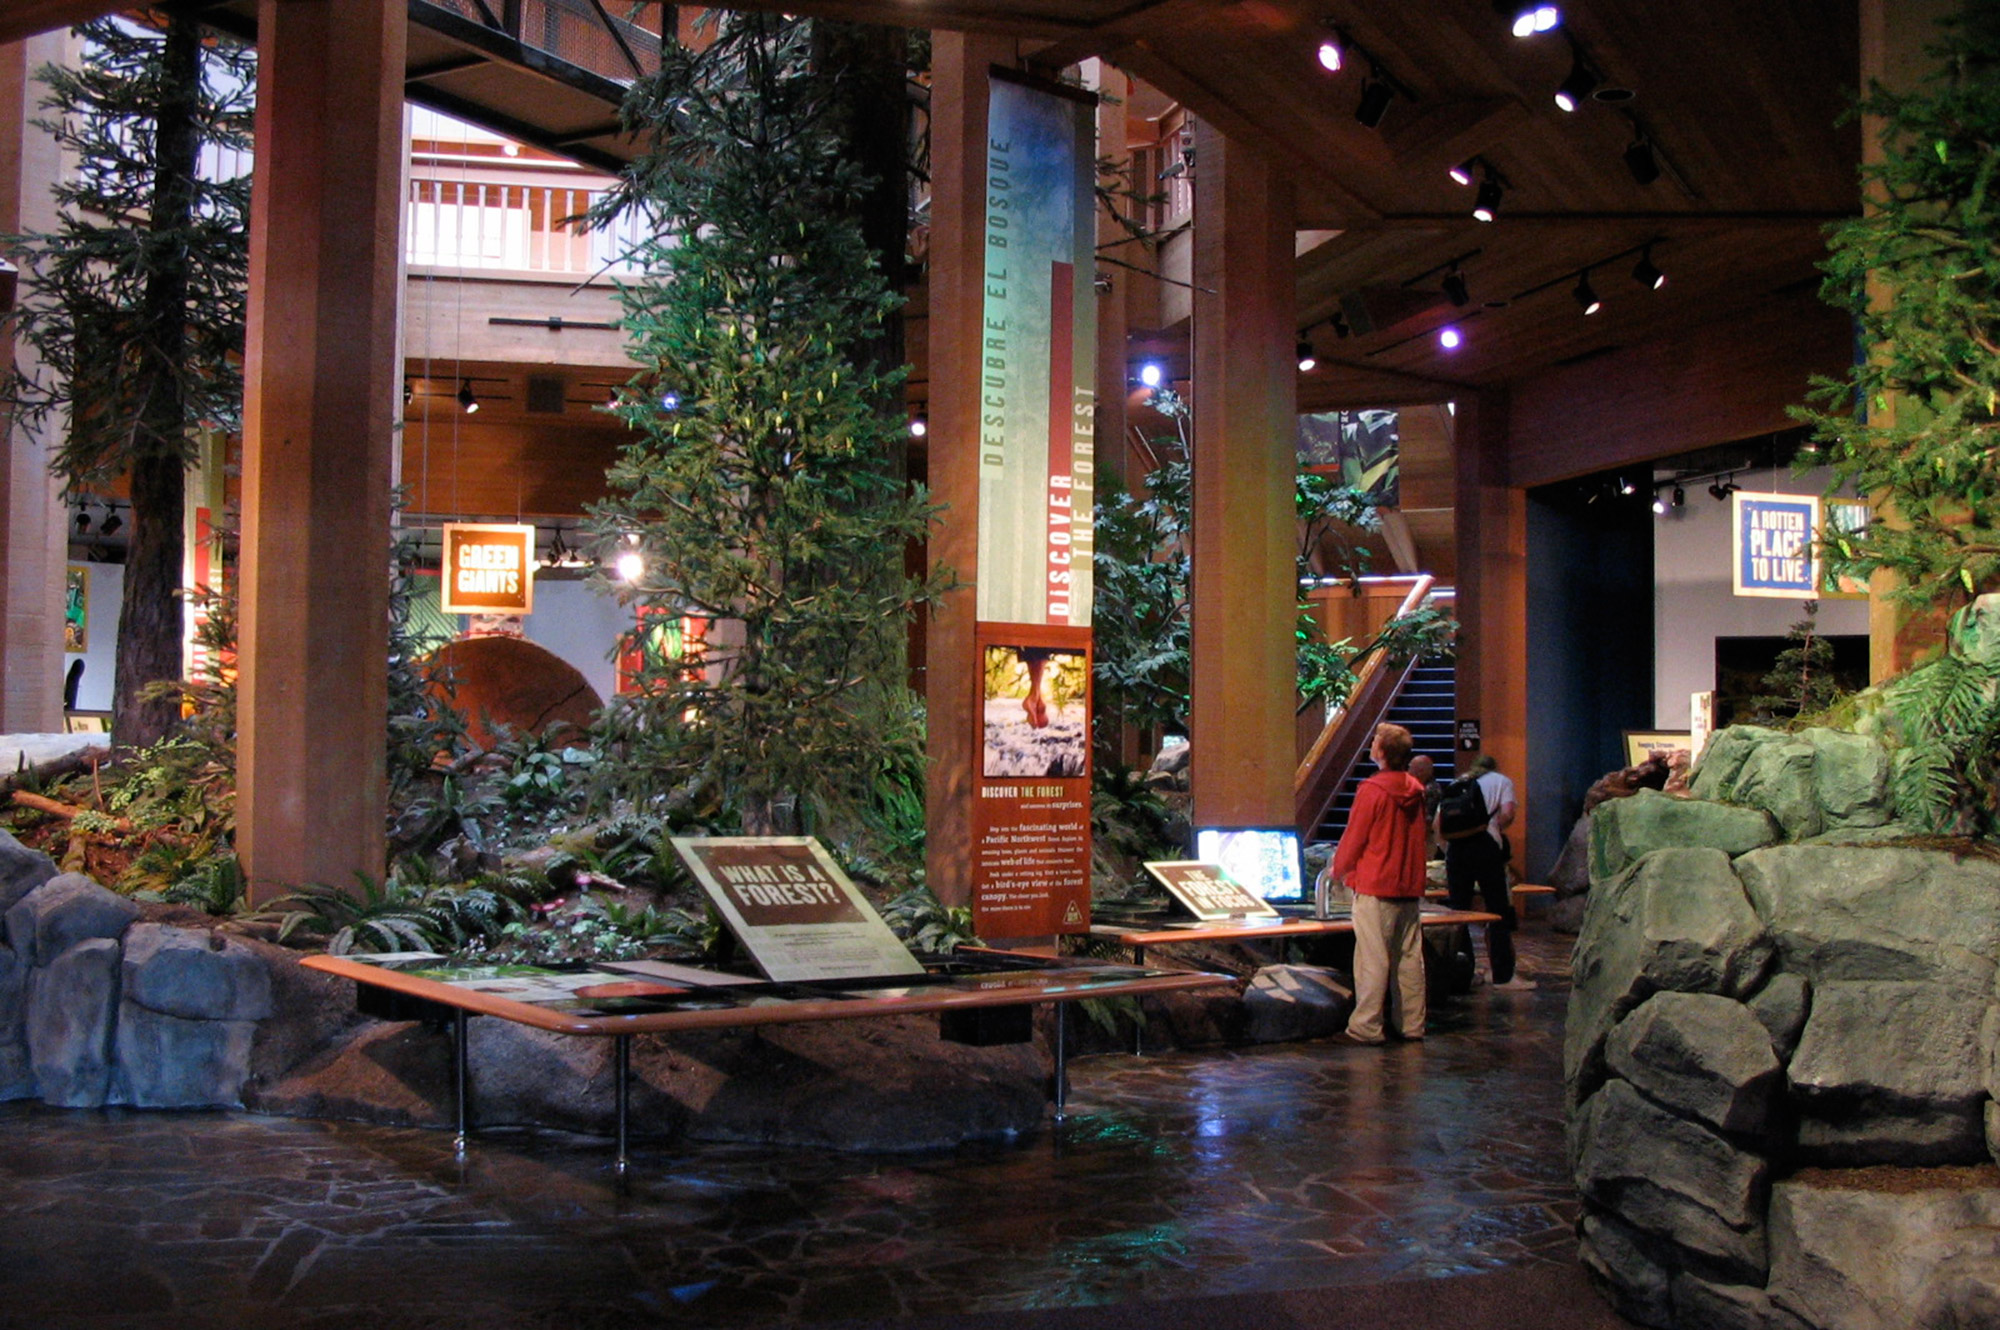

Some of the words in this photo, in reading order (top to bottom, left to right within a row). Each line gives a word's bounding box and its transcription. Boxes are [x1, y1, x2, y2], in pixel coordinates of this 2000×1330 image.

[988, 139, 1011, 248] BOSQUE
[987, 269, 1007, 300] EL
[983, 317, 1006, 467] DESCUBRE
[1073, 386, 1094, 492] FOREST
[1751, 510, 1759, 528] A
[1761, 510, 1804, 530] ROTTEN
[1073, 510, 1094, 557] THE
[1750, 528, 1804, 558] PLACE
[459, 544, 520, 570] GREEN
[1751, 558, 1769, 581] TO
[1021, 786, 1034, 797] THE
[1037, 786, 1064, 797] FOREST
[1019, 823, 1057, 832] fascinating
[1059, 822, 1077, 831] world
[986, 835, 1009, 843] Pacific
[1011, 835, 1045, 843] Northwest
[718, 865, 780, 884] WHAT
[807, 865, 827, 882] A
[1031, 879, 1048, 887] view
[732, 883, 841, 907] FOREST?
[1178, 880, 1242, 897] FOREST
[1211, 894, 1255, 908] FOCUS
